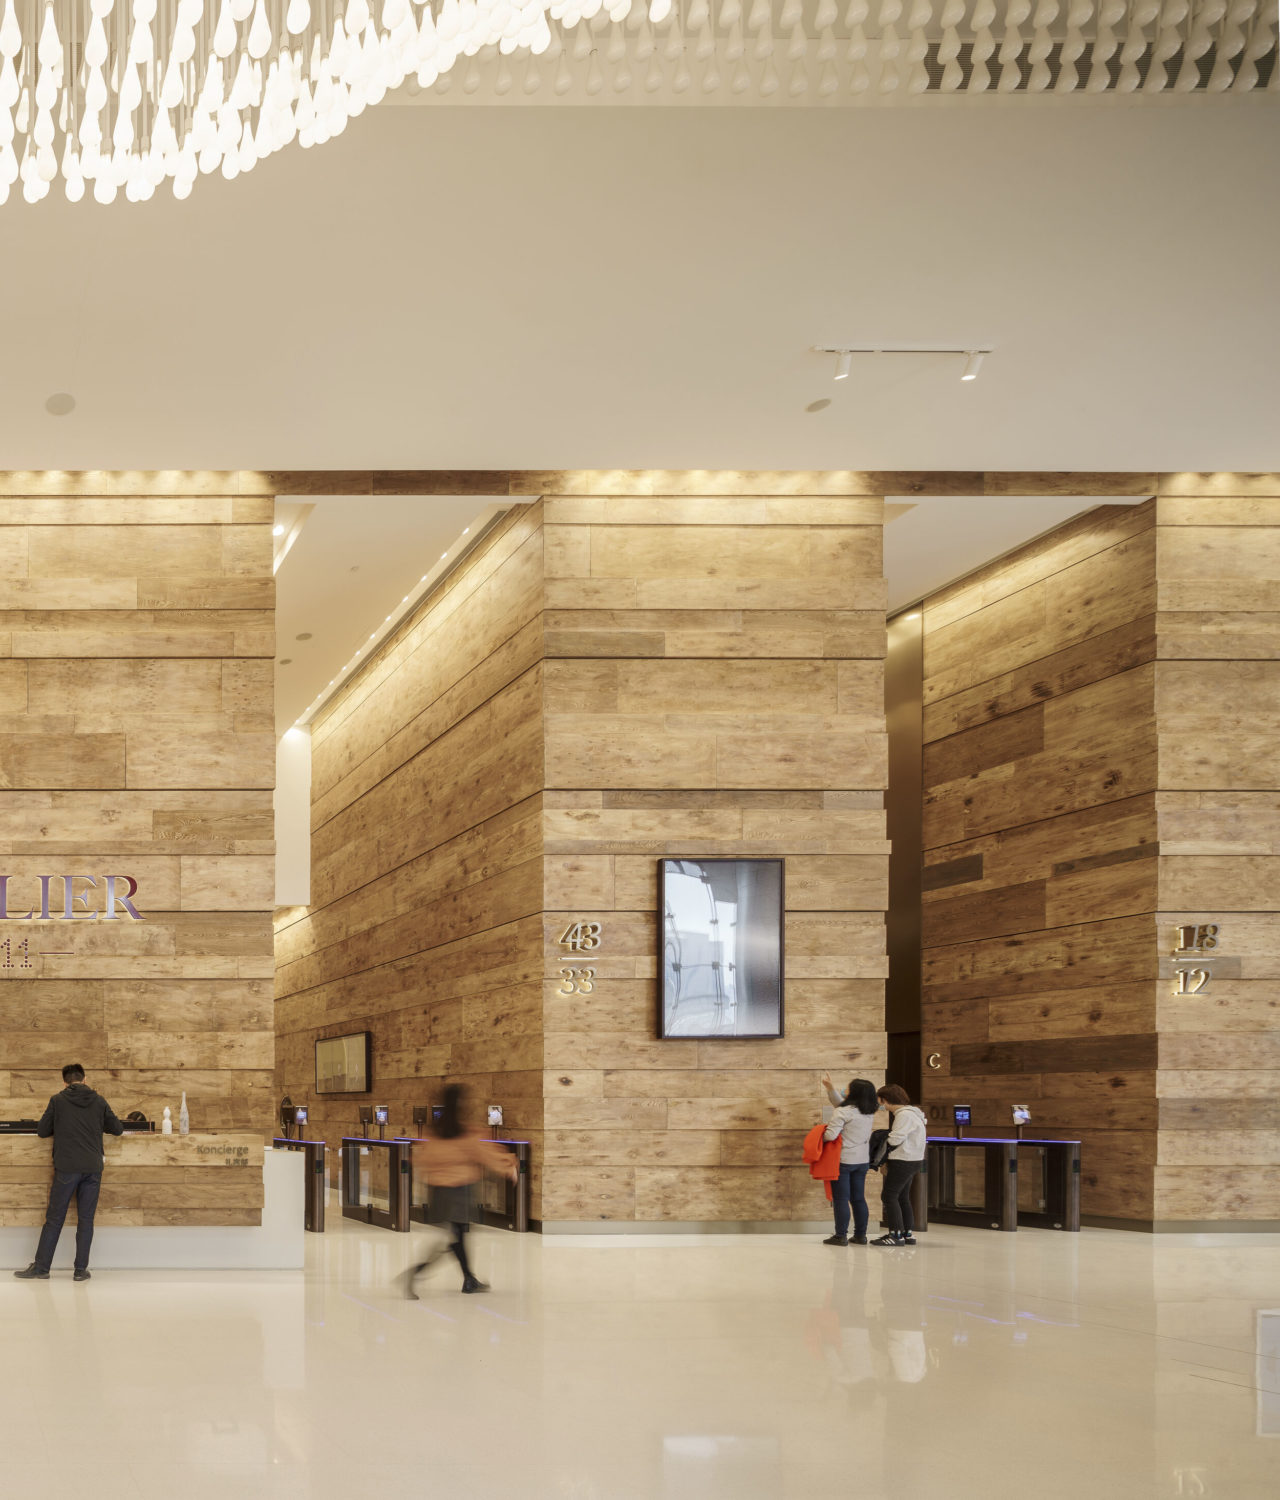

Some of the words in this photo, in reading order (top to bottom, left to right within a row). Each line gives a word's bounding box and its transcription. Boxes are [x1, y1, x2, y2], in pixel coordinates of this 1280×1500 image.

[559, 922, 601, 951] 43
[1176, 922, 1220, 951] 18
[559, 966, 597, 995] 33
[1174, 968, 1213, 995] 12
[927, 1052, 941, 1070] C
[197, 1144, 249, 1157] Koncierge
